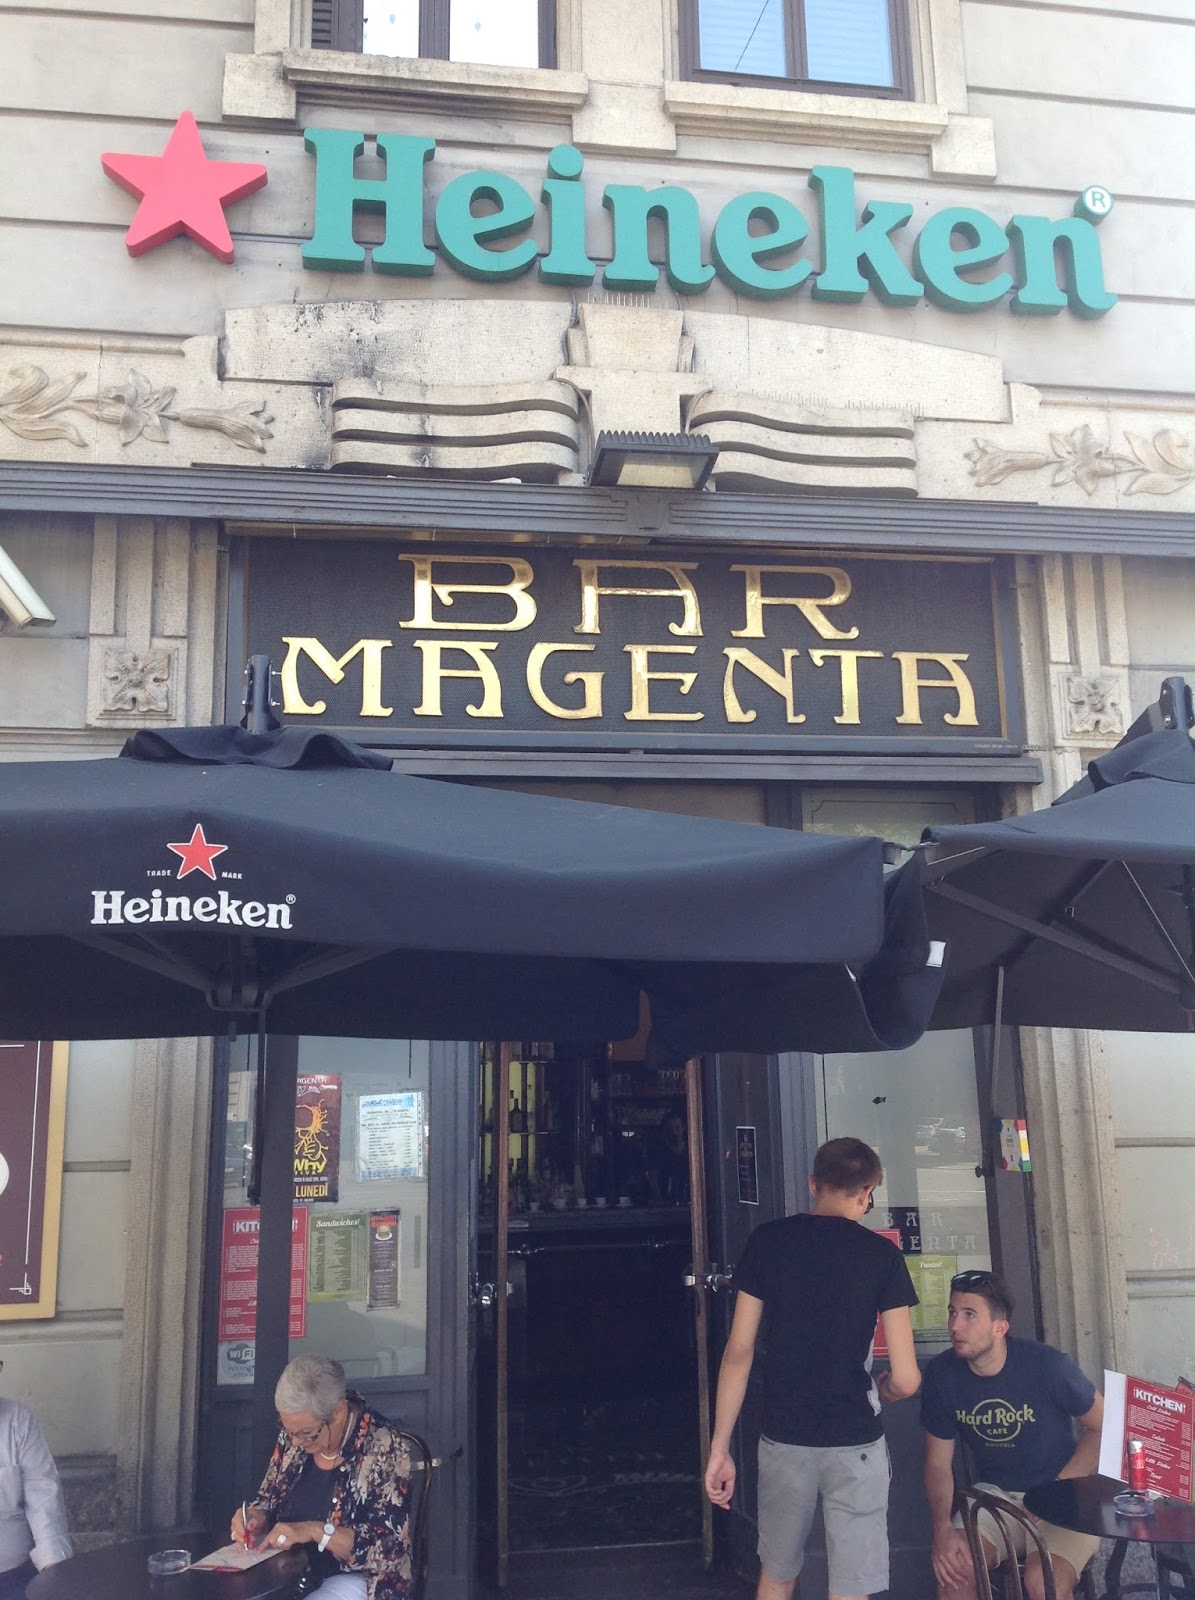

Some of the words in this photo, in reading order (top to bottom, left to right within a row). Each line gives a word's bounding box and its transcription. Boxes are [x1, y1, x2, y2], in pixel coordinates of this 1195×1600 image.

[398, 554, 861, 640] BAR
[281, 637, 980, 726] MAGENTA
[146, 869, 172, 878] TRADE
[221, 870, 243, 880] MARK
[296, 1077, 327, 1085] AGENTA
[955, 1409, 993, 1426] Hard
[994, 1403, 1037, 1427] Rock
[986, 1427, 1009, 1435] CAFE
